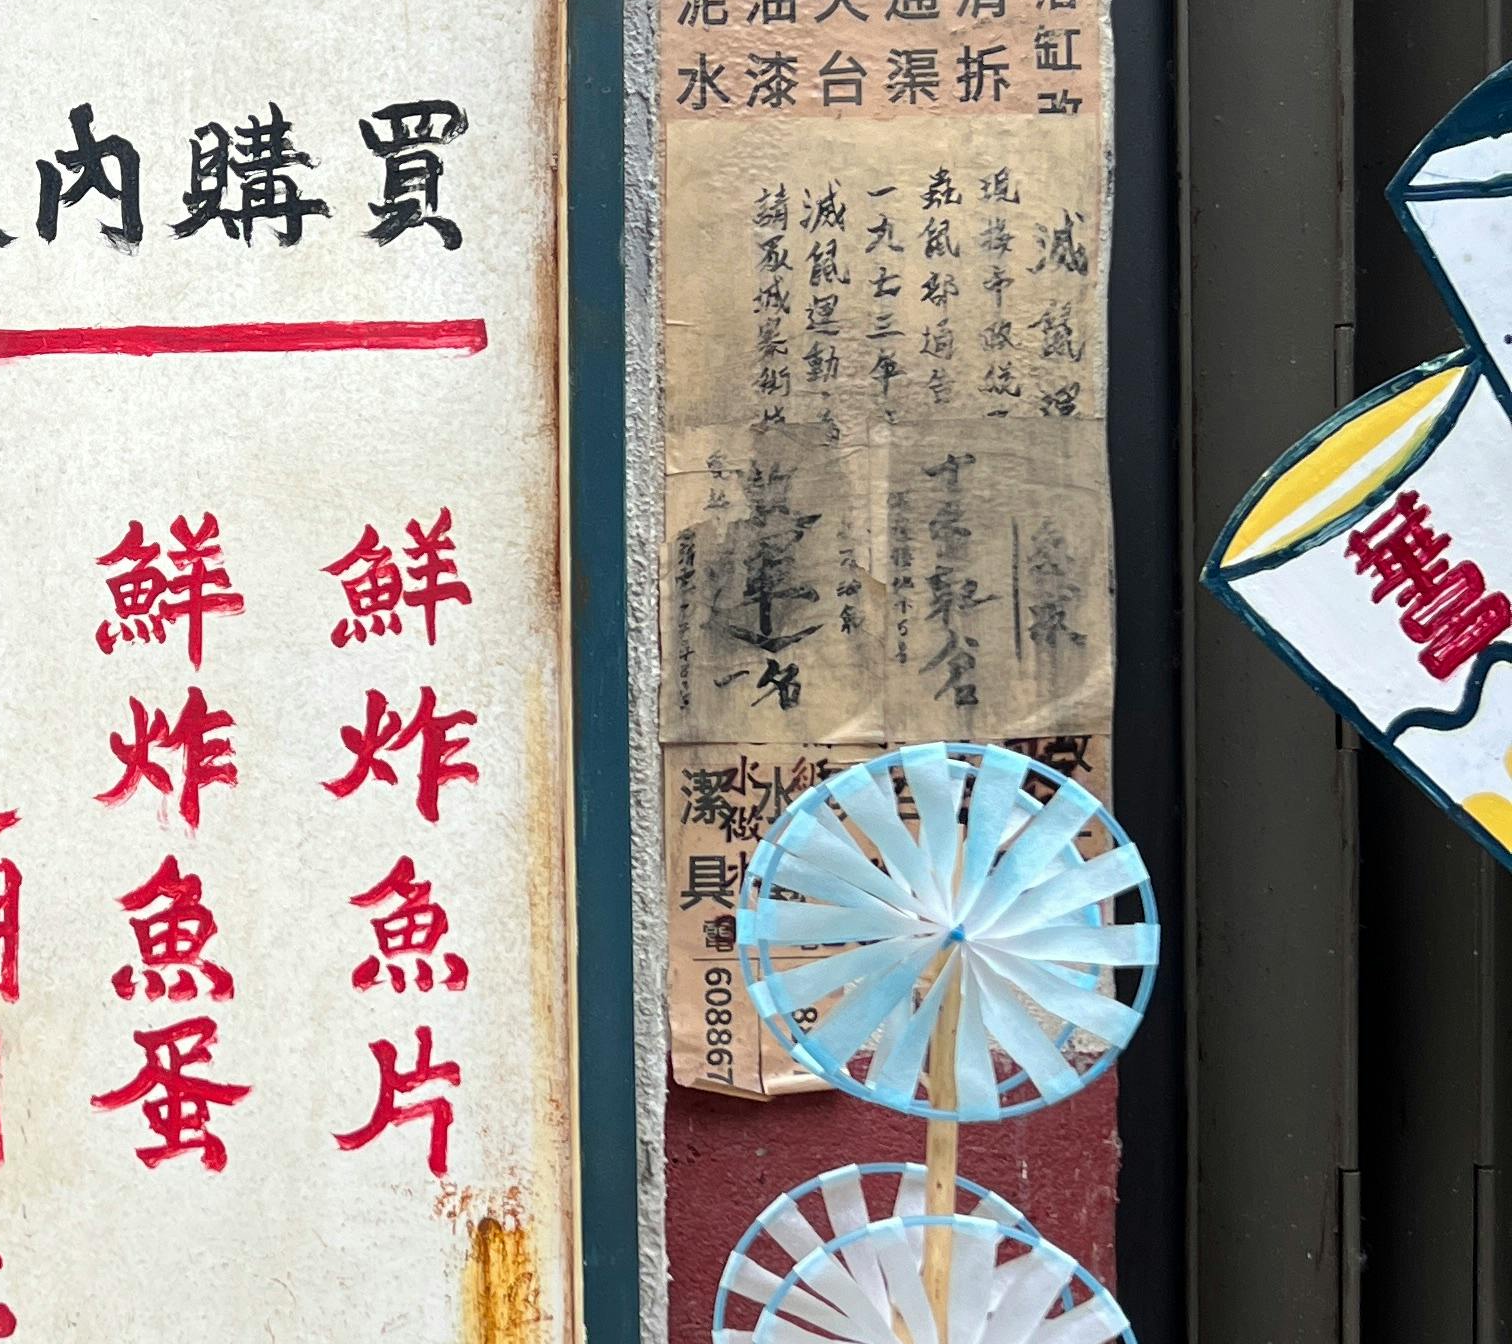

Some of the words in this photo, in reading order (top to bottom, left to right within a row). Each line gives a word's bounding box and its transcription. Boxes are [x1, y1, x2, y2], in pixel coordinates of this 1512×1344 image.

[90, 511, 253, 1173] 鮮炸魚蛋
[320, 506, 482, 1177] 鮮炸魚片
